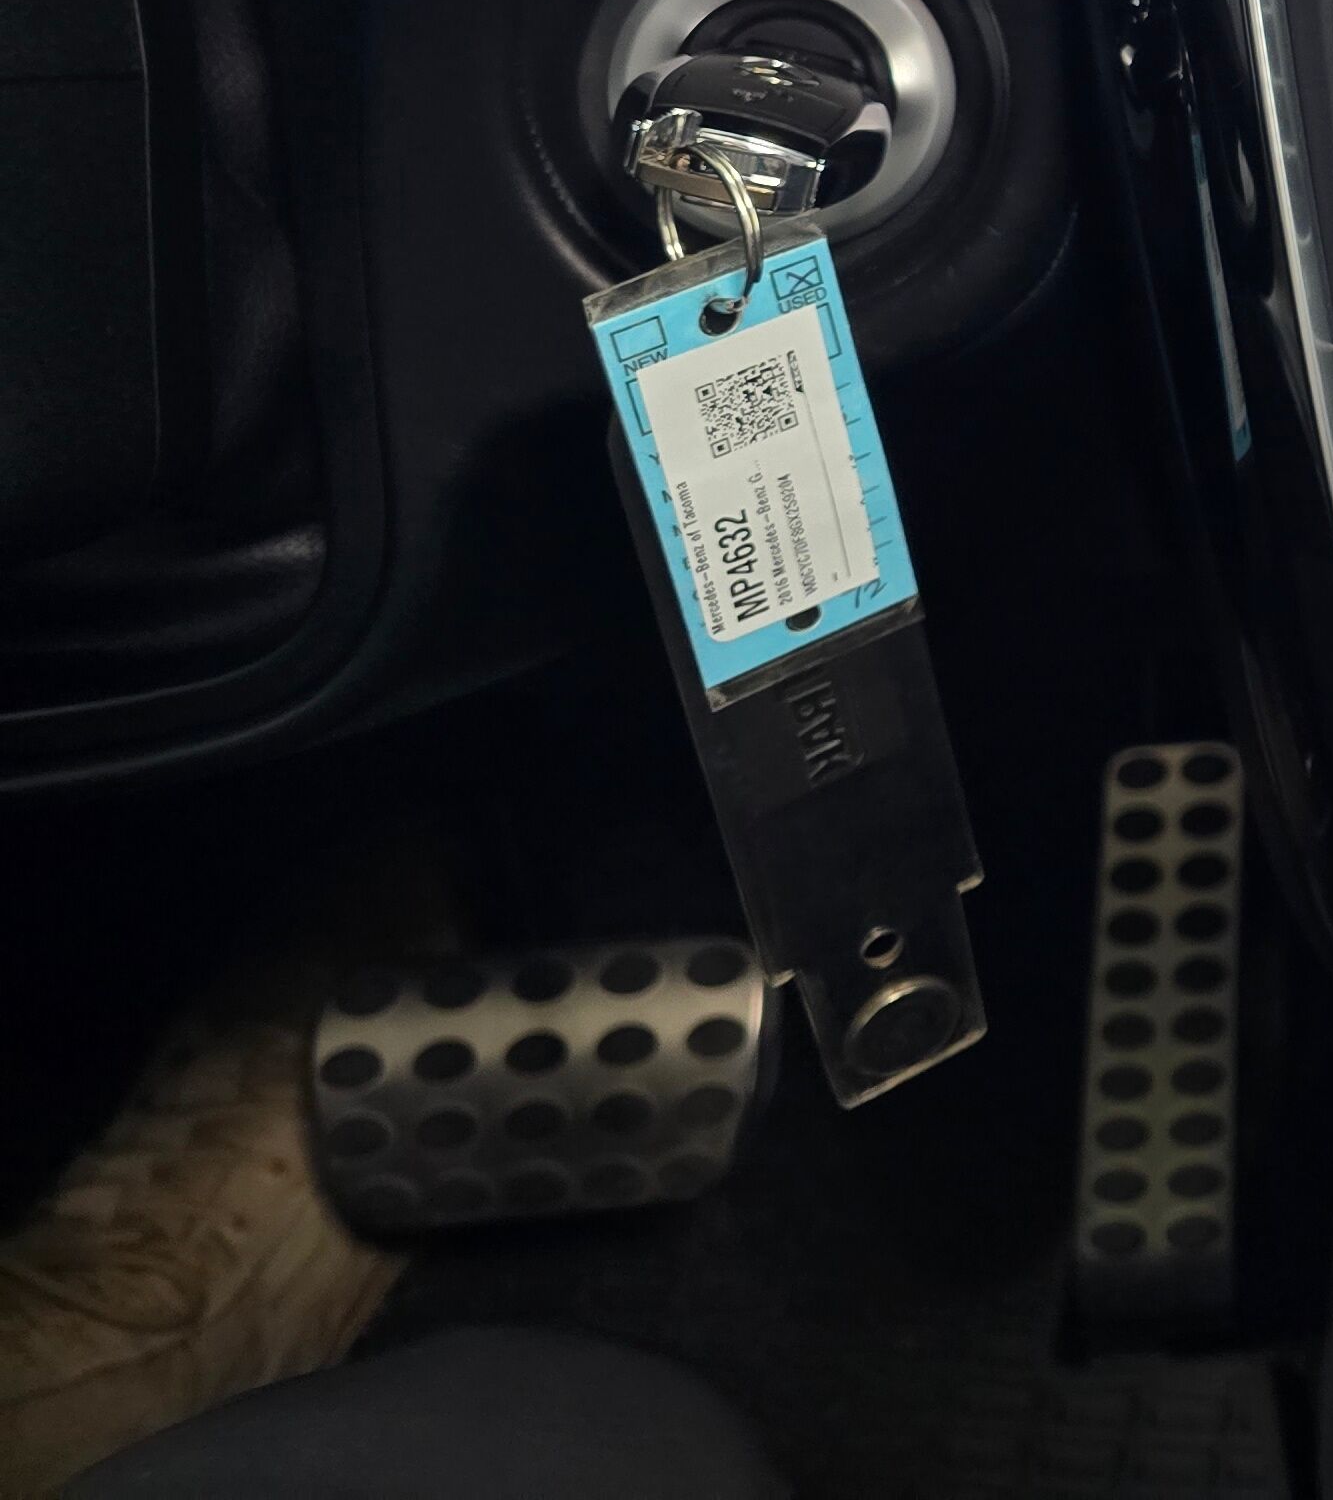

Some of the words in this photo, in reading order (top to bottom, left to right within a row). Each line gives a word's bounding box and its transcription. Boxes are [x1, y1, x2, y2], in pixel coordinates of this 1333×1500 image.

[778, 286, 828, 315] USED
[676, 480, 698, 530] Tacoma
[686, 530, 702, 542] of
[755, 485, 788, 578] Mercedes-Benz
[692, 542, 727, 636] Mercedes-Benz
[714, 508, 771, 623] MP4632
[775, 576, 793, 606] 2016
